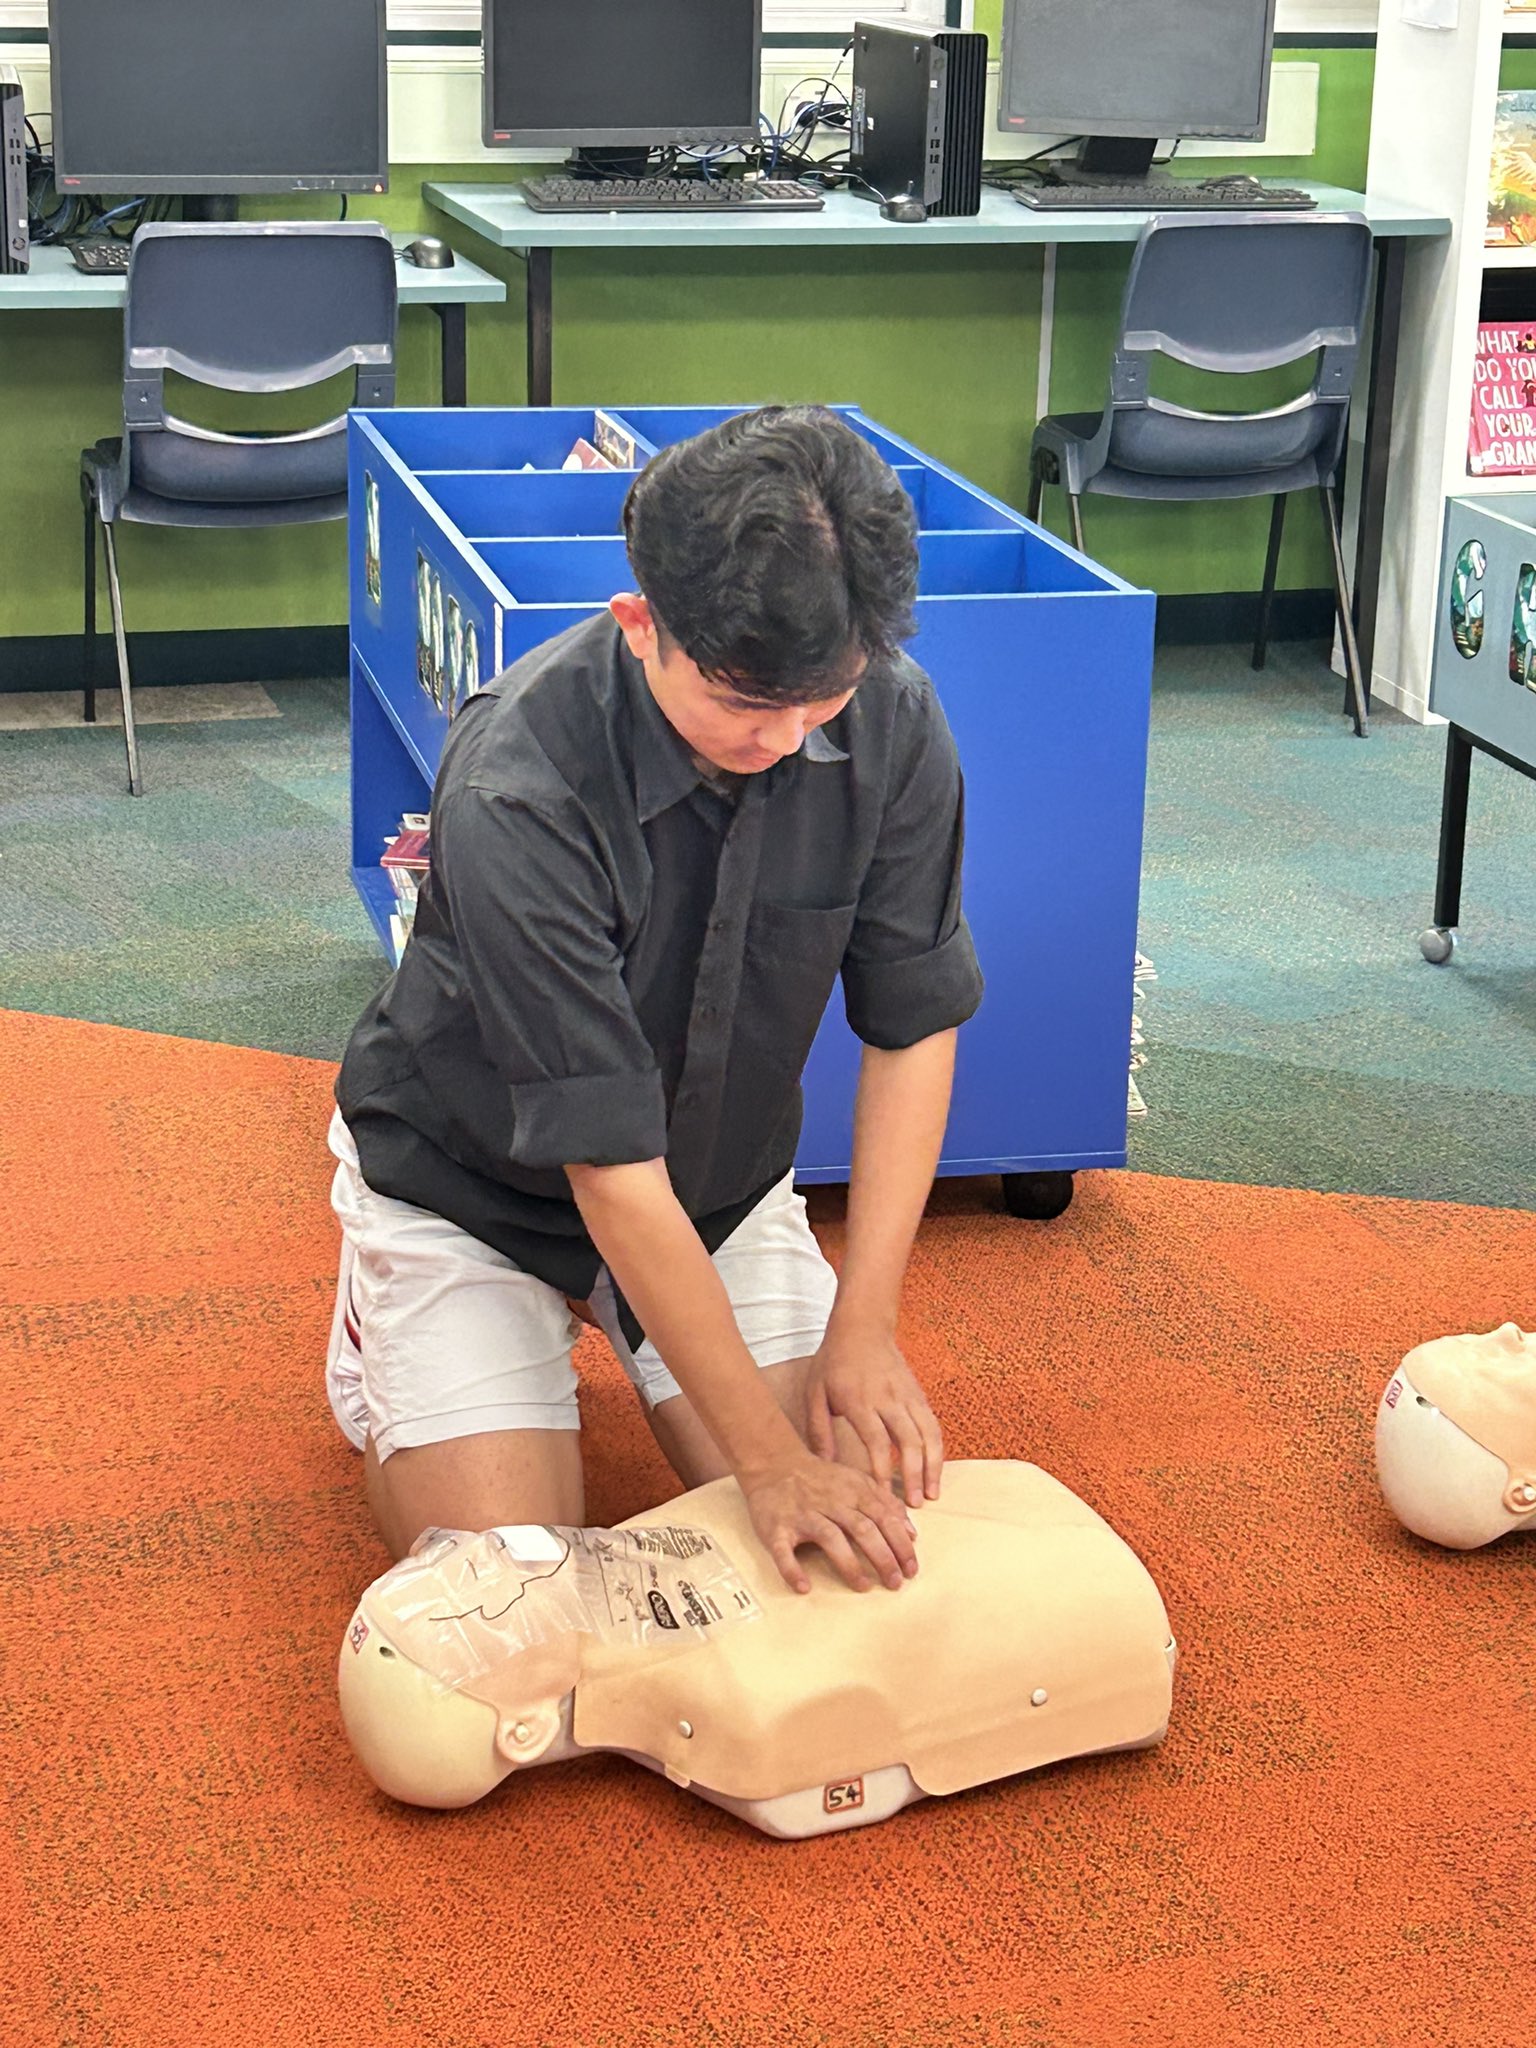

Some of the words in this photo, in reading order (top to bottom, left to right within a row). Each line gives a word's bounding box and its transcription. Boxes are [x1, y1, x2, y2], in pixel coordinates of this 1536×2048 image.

[1475, 358, 1502, 382] DO
[1480, 385, 1523, 409] CALL
[1483, 413, 1536, 438] YOUR
